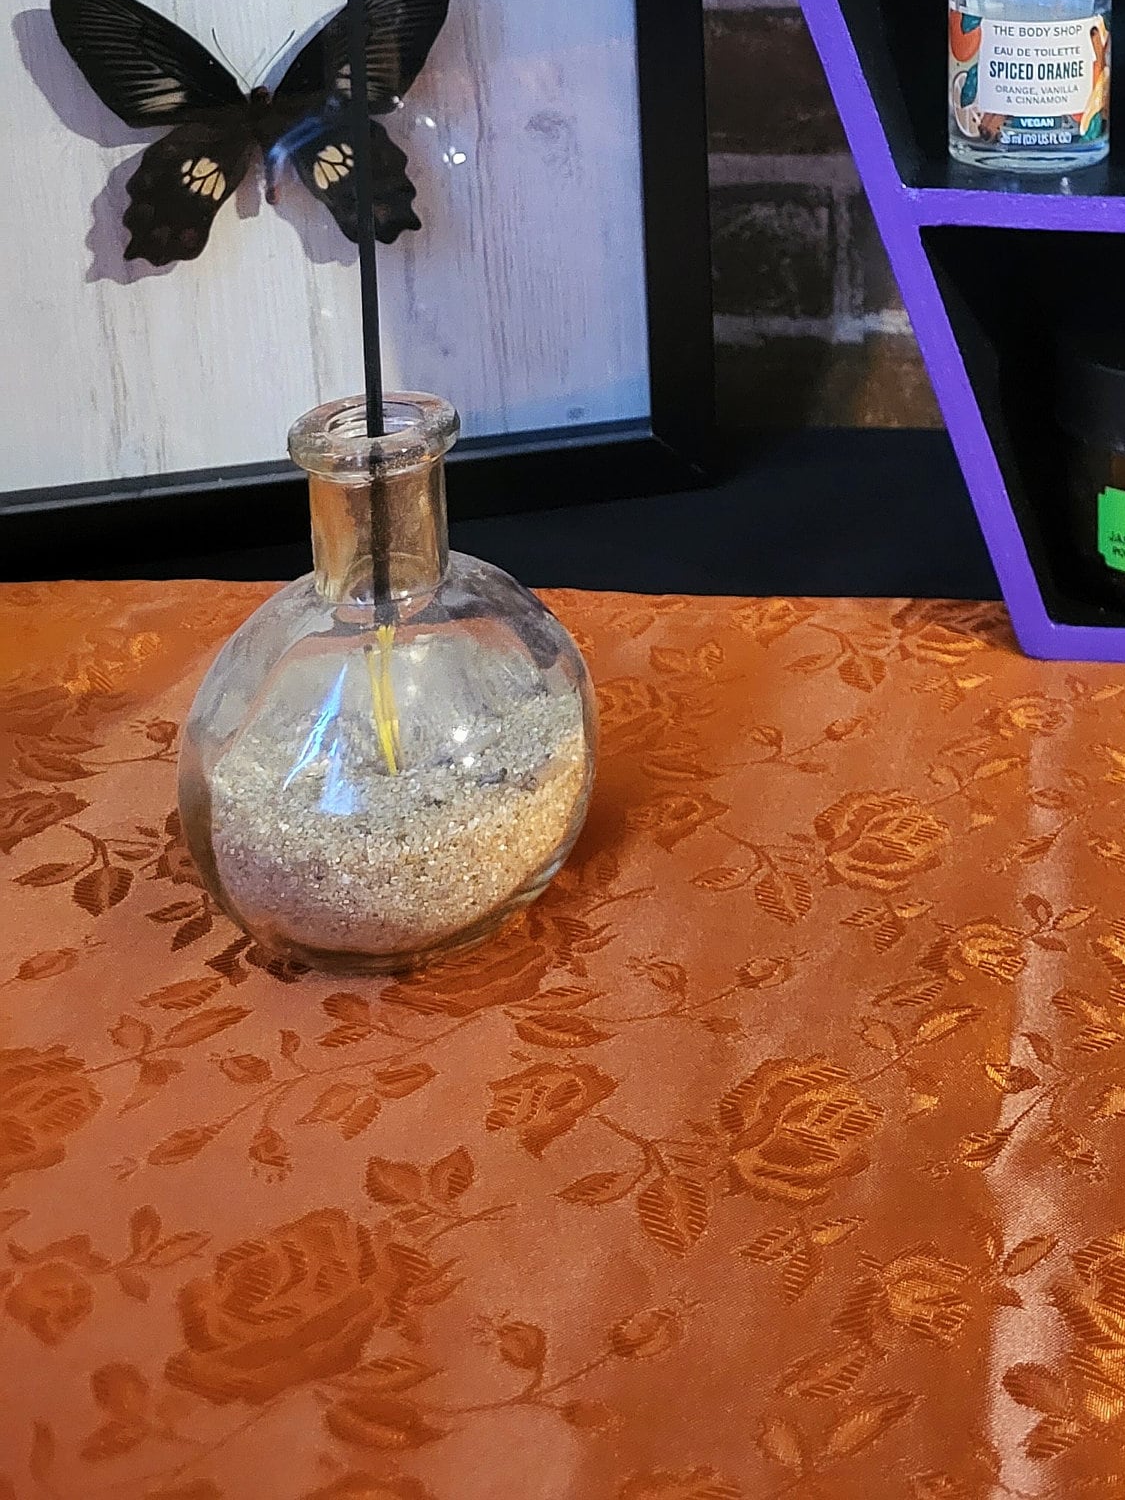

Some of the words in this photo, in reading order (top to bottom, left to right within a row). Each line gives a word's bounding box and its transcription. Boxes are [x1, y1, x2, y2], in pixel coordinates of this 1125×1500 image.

[993, 26, 1014, 36] THE
[1019, 27, 1050, 37] BODY
[1054, 25, 1082, 37] SHOP
[994, 46, 1013, 56] EAU
[1017, 48, 1031, 57] DE
[1034, 46, 1081, 57] TOILETTE
[990, 60, 1034, 80] SPICED
[1038, 60, 1084, 81] ORANGE
[995, 85, 1038, 96] ORANGE,
[1041, 85, 1079, 95] VANILLA
[1015, 95, 1069, 105] CINNAMON
[1020, 118, 1054, 128] VEGAN
